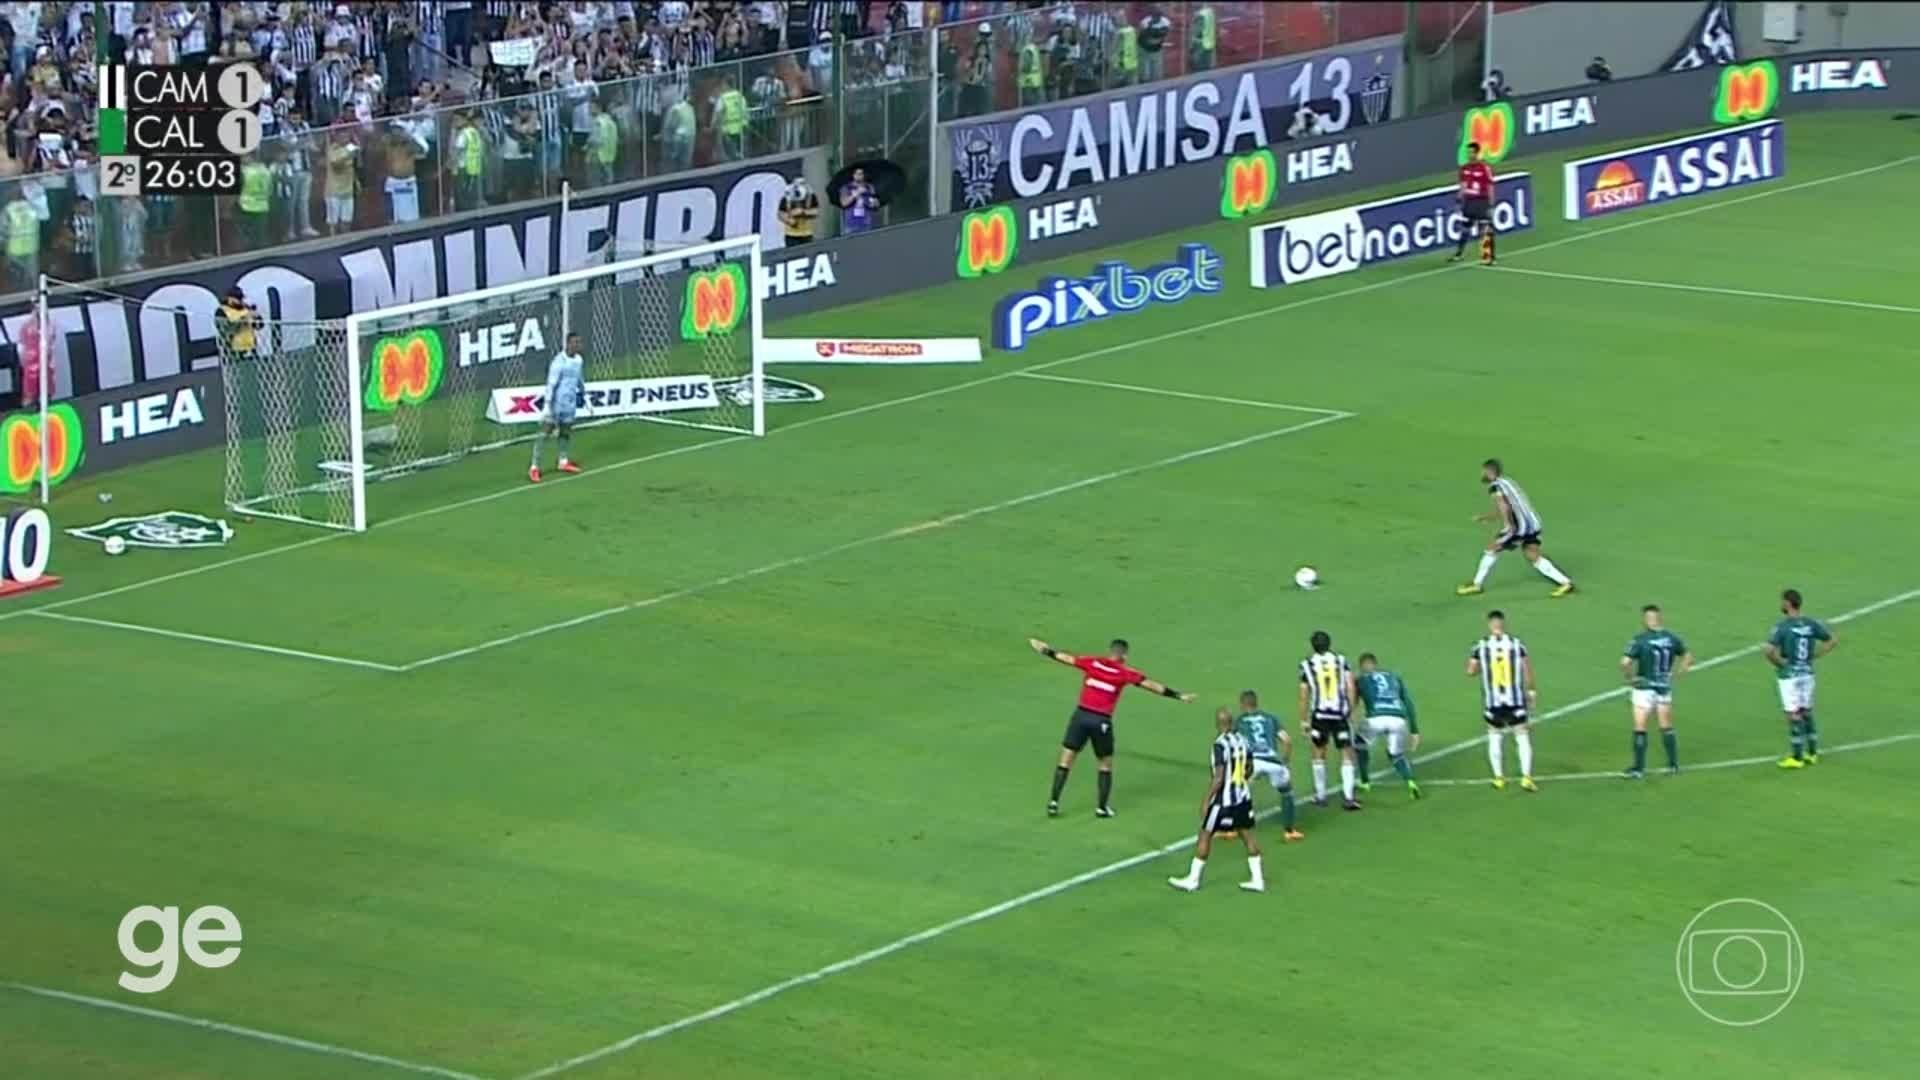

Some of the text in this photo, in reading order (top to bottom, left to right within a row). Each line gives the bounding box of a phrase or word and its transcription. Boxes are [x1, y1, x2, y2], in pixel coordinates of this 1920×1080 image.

[1009, 57, 1352, 197] CAMISA 13
[1009, 249, 1220, 348] pixbet
[842, 343, 919, 356] MEGATRON
[631, 383, 710, 405] PNEUS
